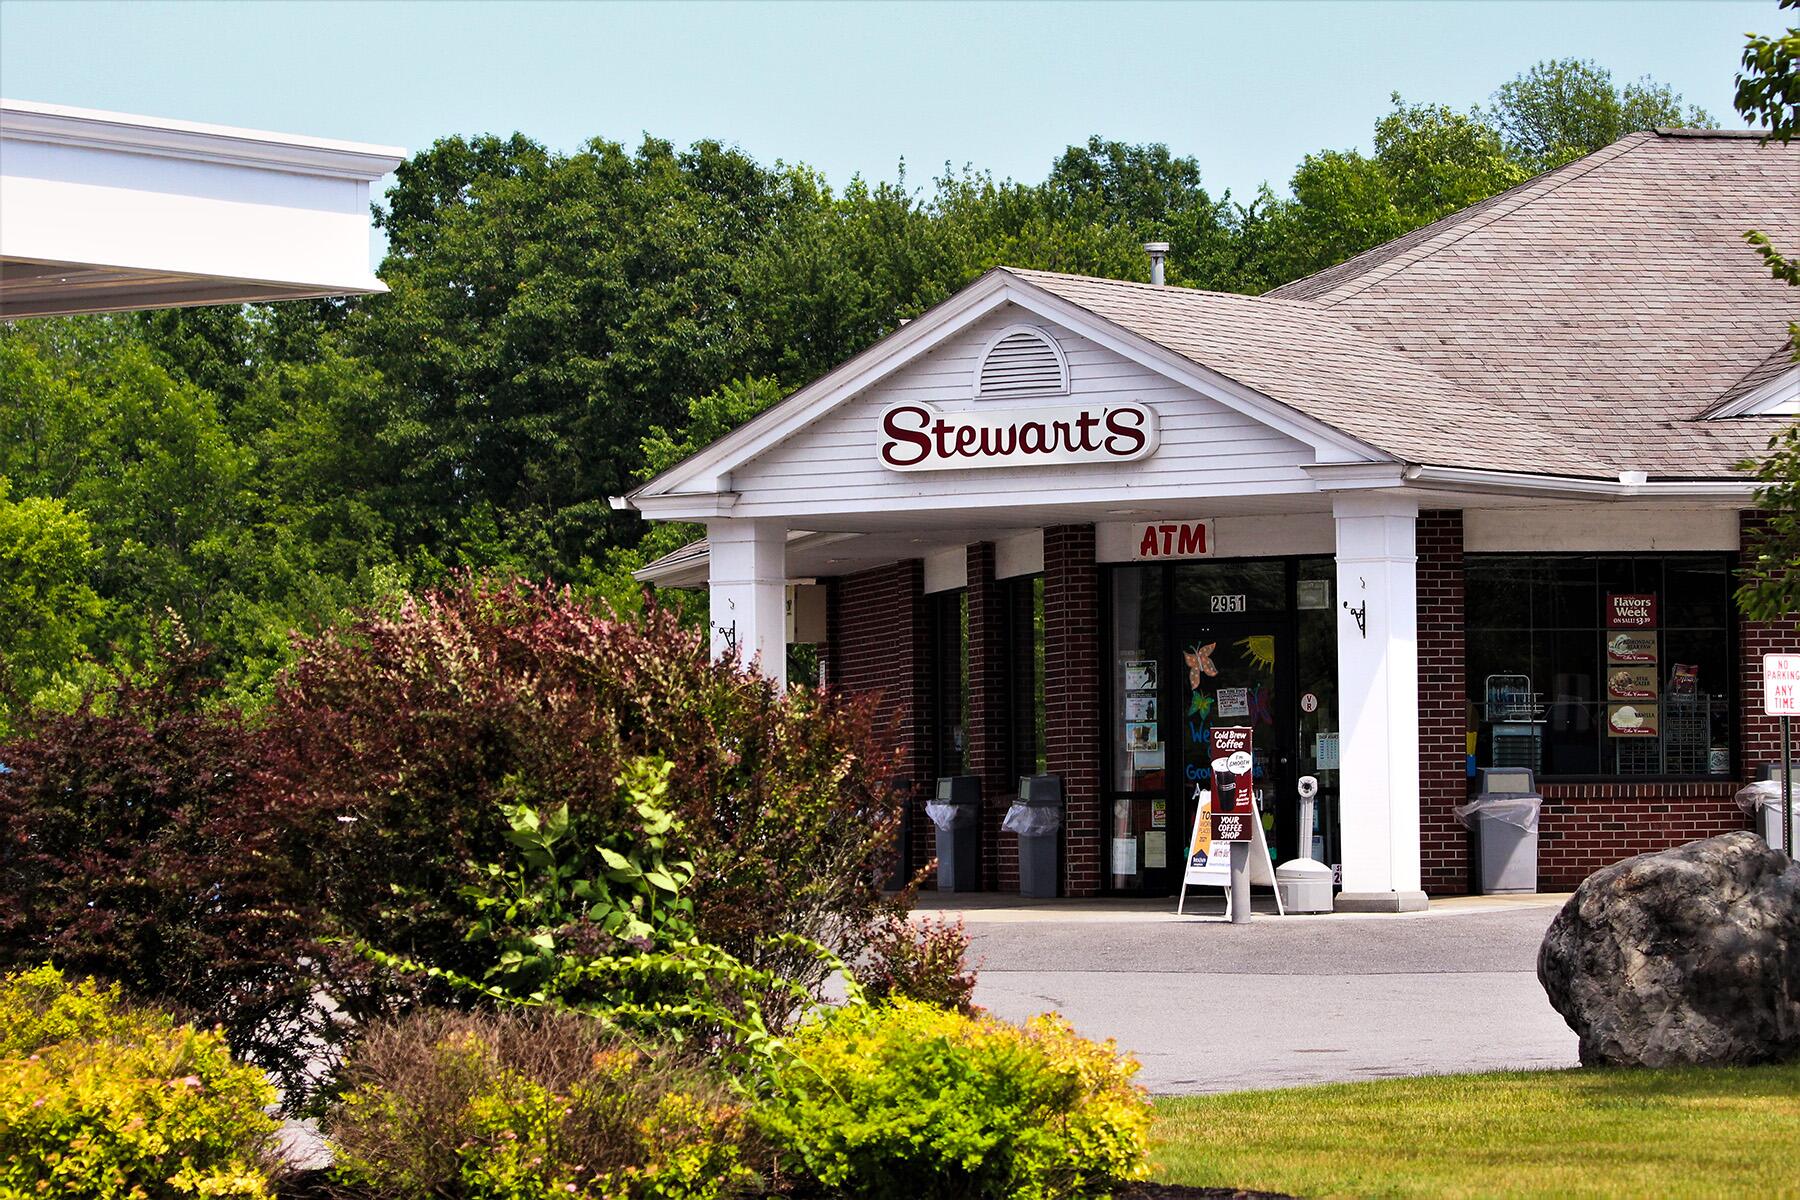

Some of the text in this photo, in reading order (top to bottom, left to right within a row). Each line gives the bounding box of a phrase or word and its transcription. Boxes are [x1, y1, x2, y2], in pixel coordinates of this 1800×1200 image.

[1140, 523, 1207, 556] ATM
[1212, 596, 1244, 611] 2951
[1613, 597, 1651, 606] Flavors
[1616, 607, 1648, 616] Week
[1778, 660, 1788, 669] NO
[1767, 671, 1800, 680] PARKING
[1775, 685, 1792, 696] ANY
[1775, 697, 1794, 709] TIME
[1214, 731, 1247, 739] Cold Brew
[1216, 739, 1244, 749] Coffee
[1221, 816, 1239, 824] YOUR
[1218, 824, 1243, 832] COFFEE
[1221, 832, 1240, 840] SHOP
